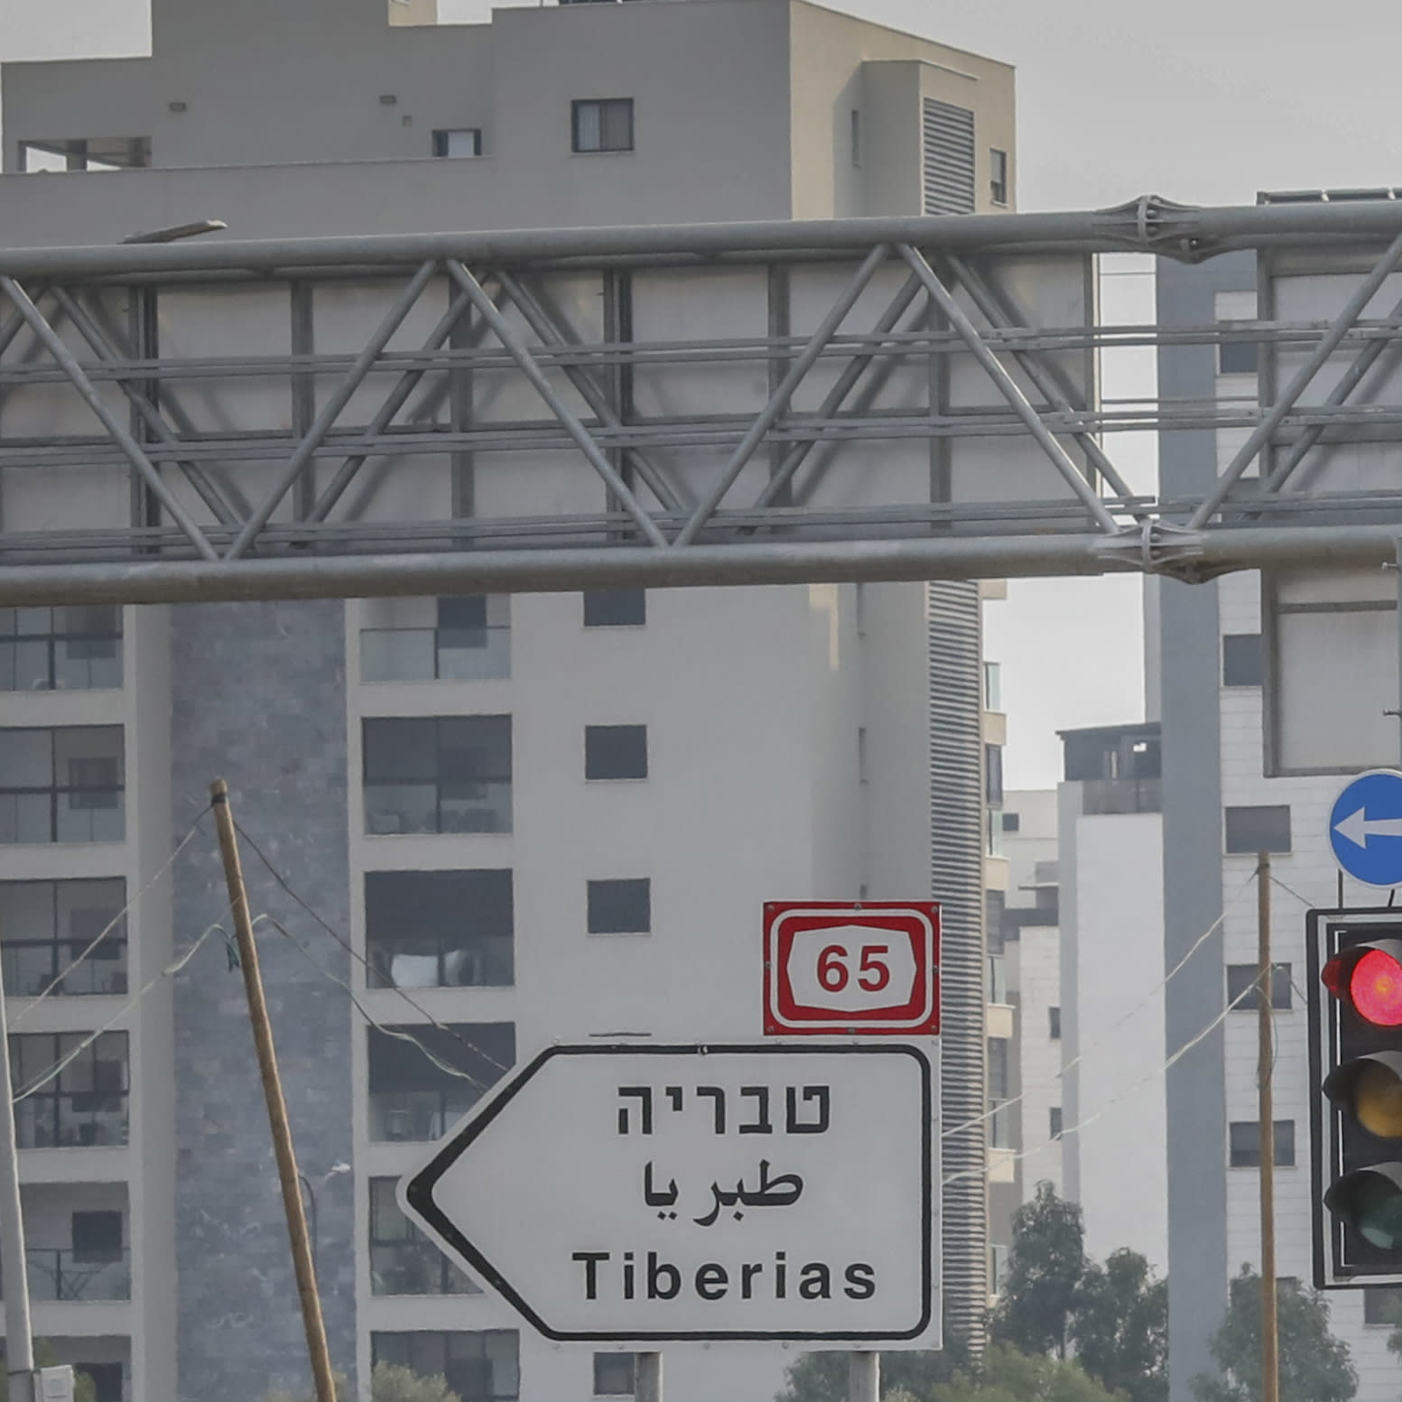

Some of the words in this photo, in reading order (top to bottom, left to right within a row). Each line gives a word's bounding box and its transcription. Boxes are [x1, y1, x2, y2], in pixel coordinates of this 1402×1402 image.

[816, 944, 891, 993] 65
[617, 1085, 831, 1136] טבריה
[643, 1159, 805, 1227] طبريا
[571, 1251, 877, 1301] Tiberias
